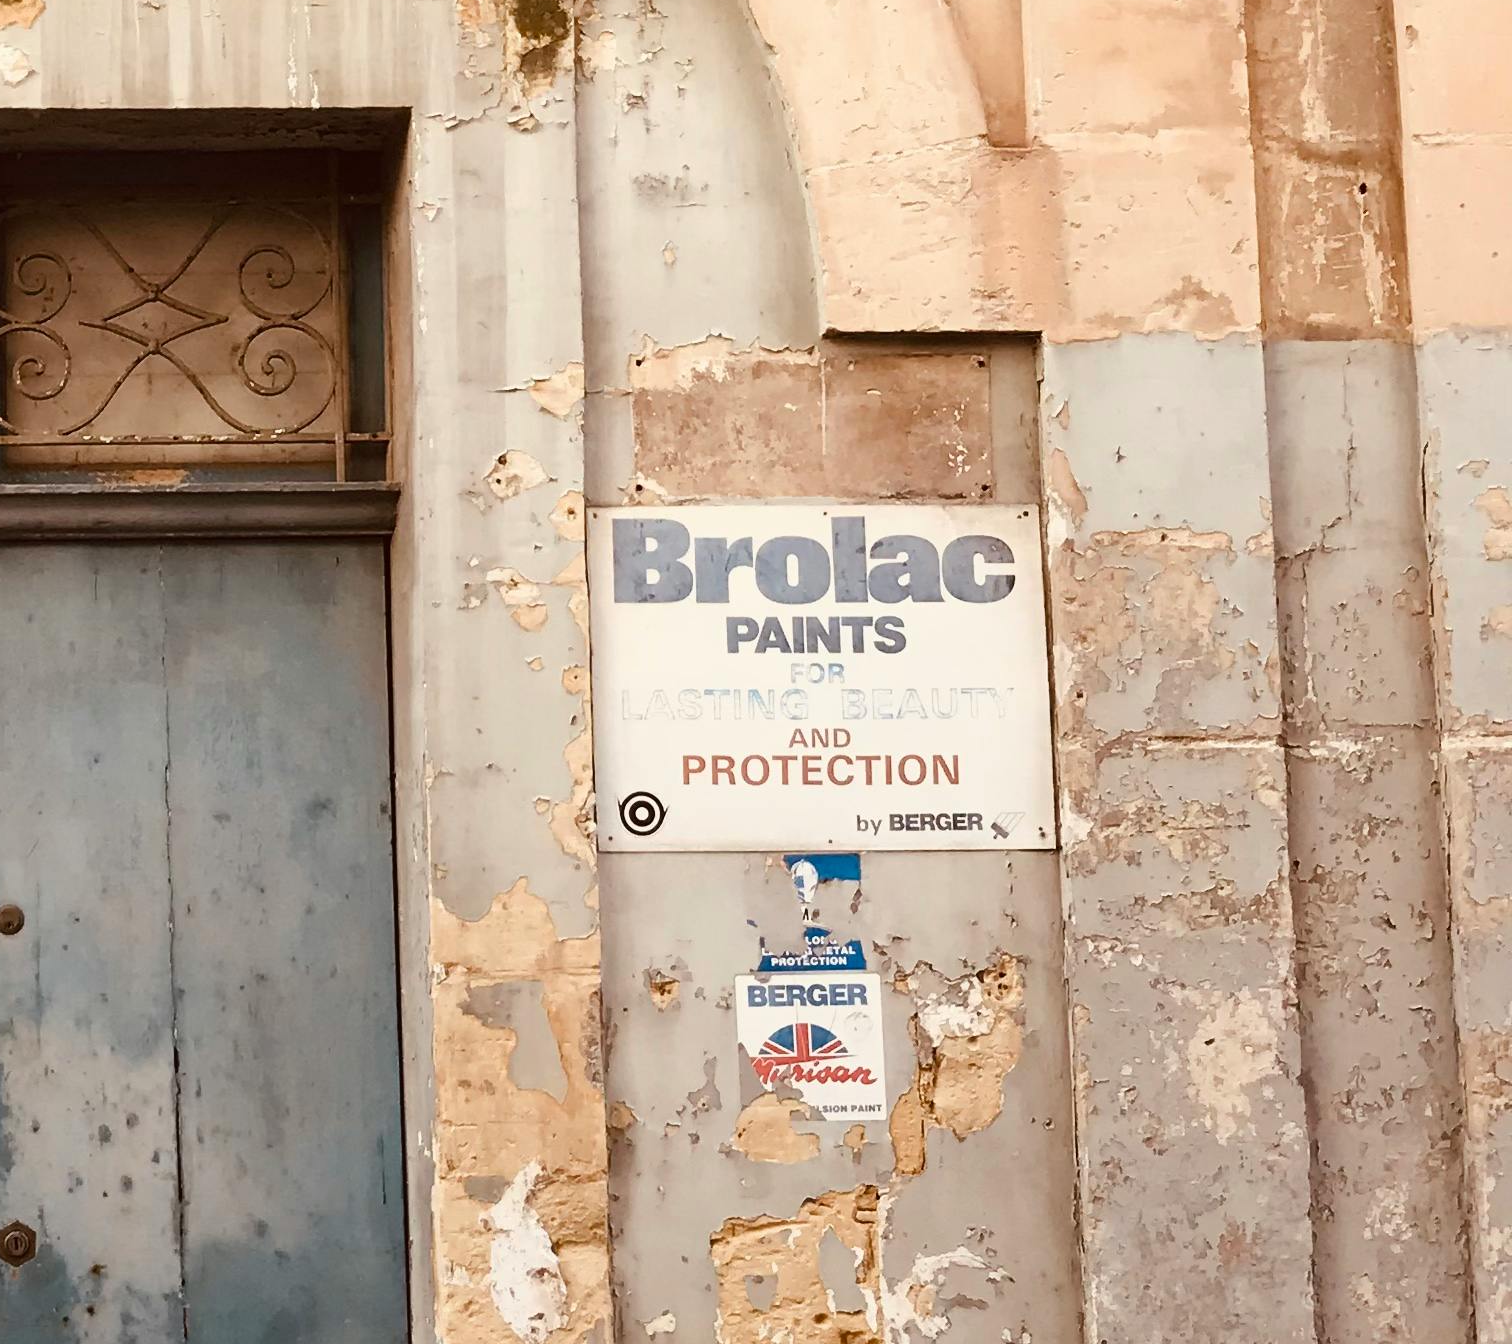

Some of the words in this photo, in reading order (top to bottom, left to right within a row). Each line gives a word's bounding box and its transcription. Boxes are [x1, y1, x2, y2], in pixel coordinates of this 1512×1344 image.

[611, 516, 1016, 605] Brolac
[726, 616, 907, 655] PAINTS
[790, 662, 846, 684] FOR
[621, 688, 810, 721] LASTING
[841, 687, 1015, 720] BEAUTY
[788, 728, 851, 749] AND
[682, 754, 960, 787] PROTECTION
[856, 813, 883, 834] by
[888, 812, 983, 832] BERGER
[771, 956, 847, 966] PROTECTION
[823, 946, 856, 955] ETAL
[747, 983, 868, 1007] BERGER
[851, 1104, 883, 1113] PAINT
